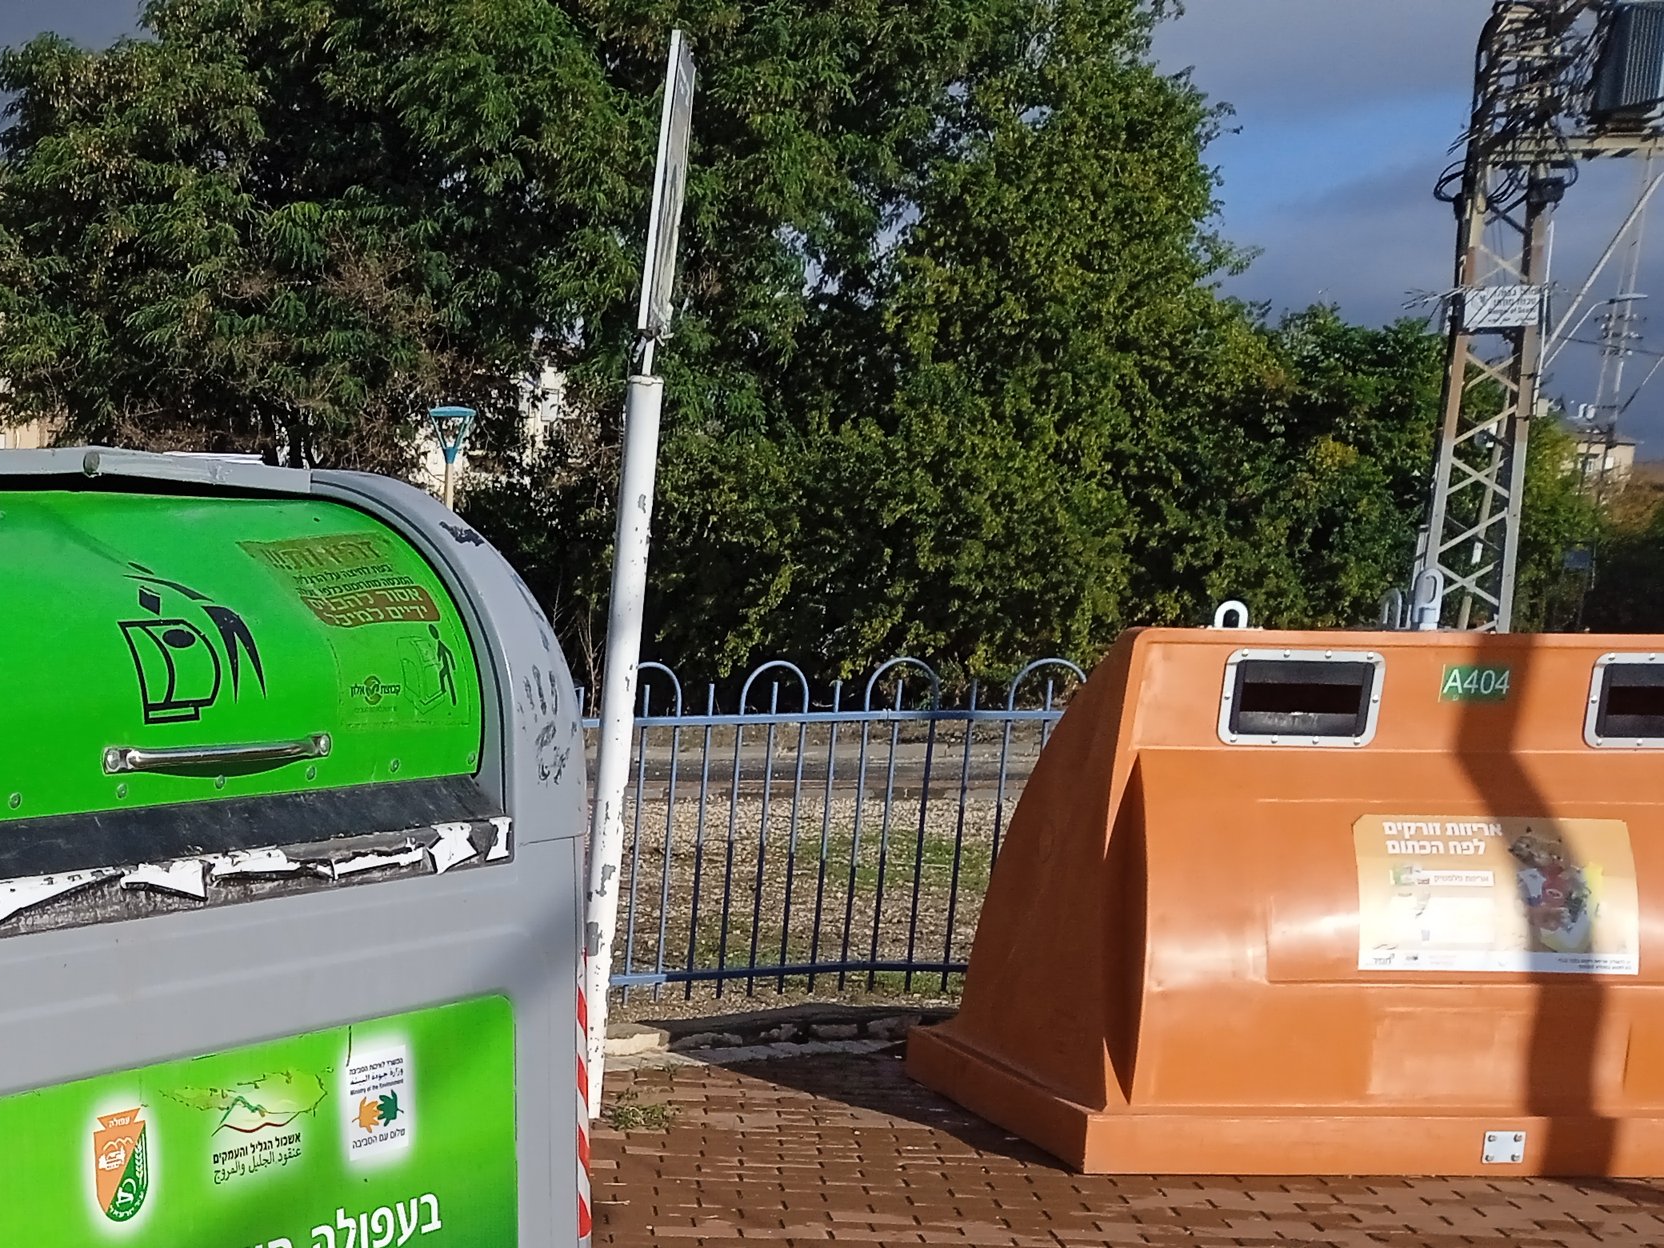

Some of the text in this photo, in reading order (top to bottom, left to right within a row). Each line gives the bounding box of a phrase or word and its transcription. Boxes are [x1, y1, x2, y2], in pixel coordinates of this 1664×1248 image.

[375, 588, 423, 602] אסור
[385, 605, 428, 619] ידיים
[1442, 668, 1510, 695] A404
[1382, 821, 1502, 839] אריזות זורקים
[1385, 838, 1486, 855] לפח הכתום
[108, 1116, 131, 1129] עפולה
[352, 1128, 405, 1149] שלום עם הסביבה
[212, 1132, 302, 1165] אשכול הגליל והעמקים
[248, 1151, 275, 1173] الجليل
